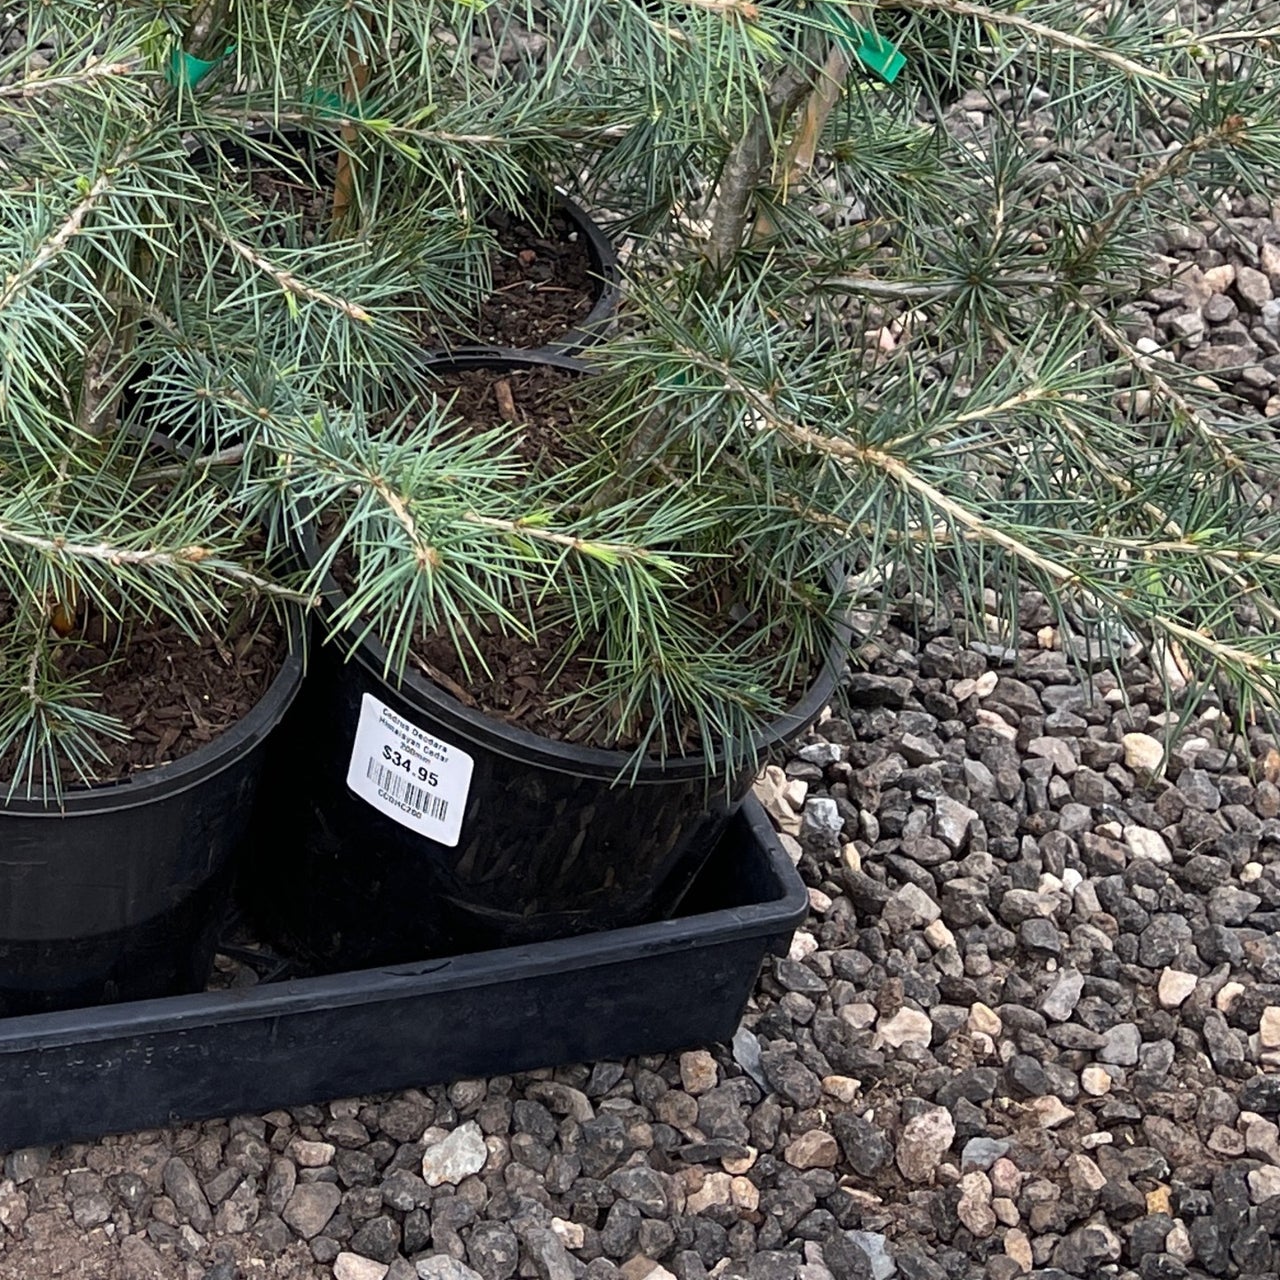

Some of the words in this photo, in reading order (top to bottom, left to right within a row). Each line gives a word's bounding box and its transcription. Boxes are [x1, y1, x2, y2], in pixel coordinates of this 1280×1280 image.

[379, 716, 421, 748] Himalayan
[423, 745, 449, 763] Cedar
[383, 707, 410, 732] Cedrus
[412, 728, 448, 753] Deodara
[382, 744, 439, 787] $34.95
[400, 742, 431, 765] 200mm
